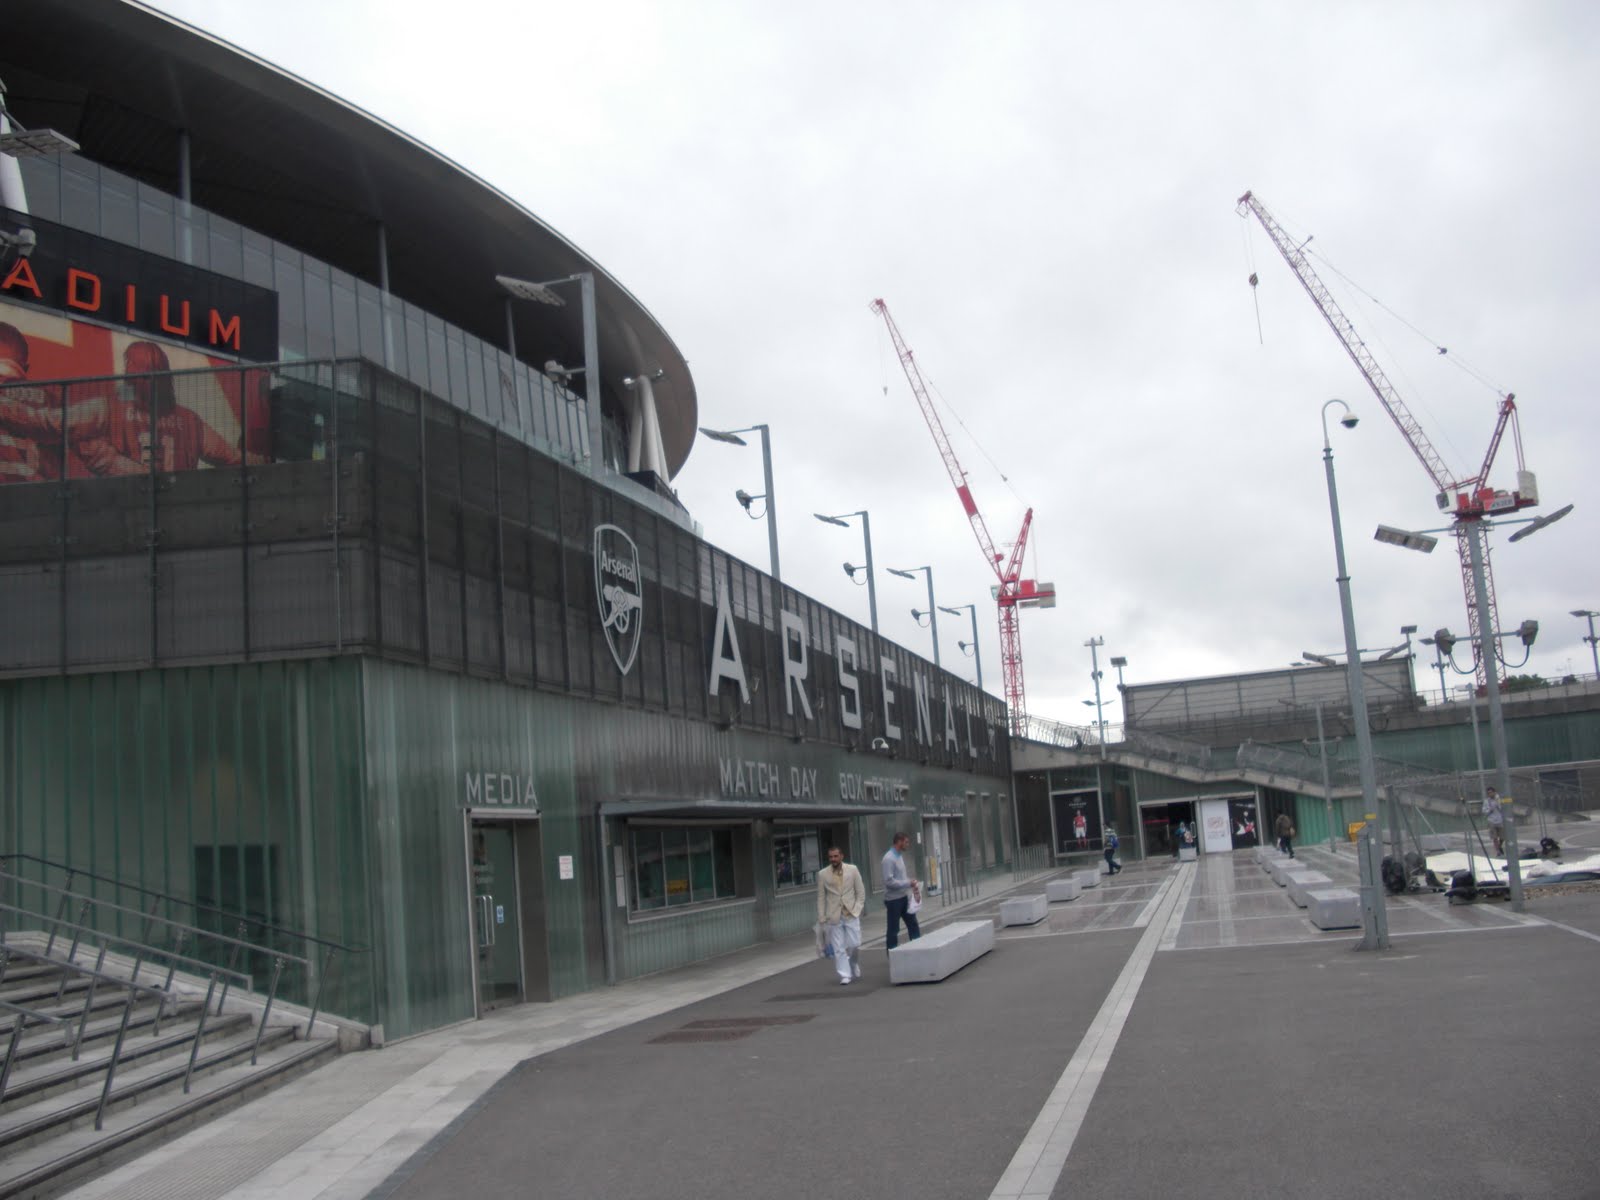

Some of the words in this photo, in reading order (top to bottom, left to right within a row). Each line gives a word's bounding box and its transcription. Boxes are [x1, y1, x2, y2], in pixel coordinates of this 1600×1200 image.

[1, 257, 242, 351] ADIUM
[601, 550, 636, 584] Arsenal
[709, 578, 977, 758] ARSENAL
[465, 772, 538, 804] MEDIA
[719, 757, 780, 796] MATCH
[790, 766, 817, 798] DAY
[839, 772, 864, 800] BOX
